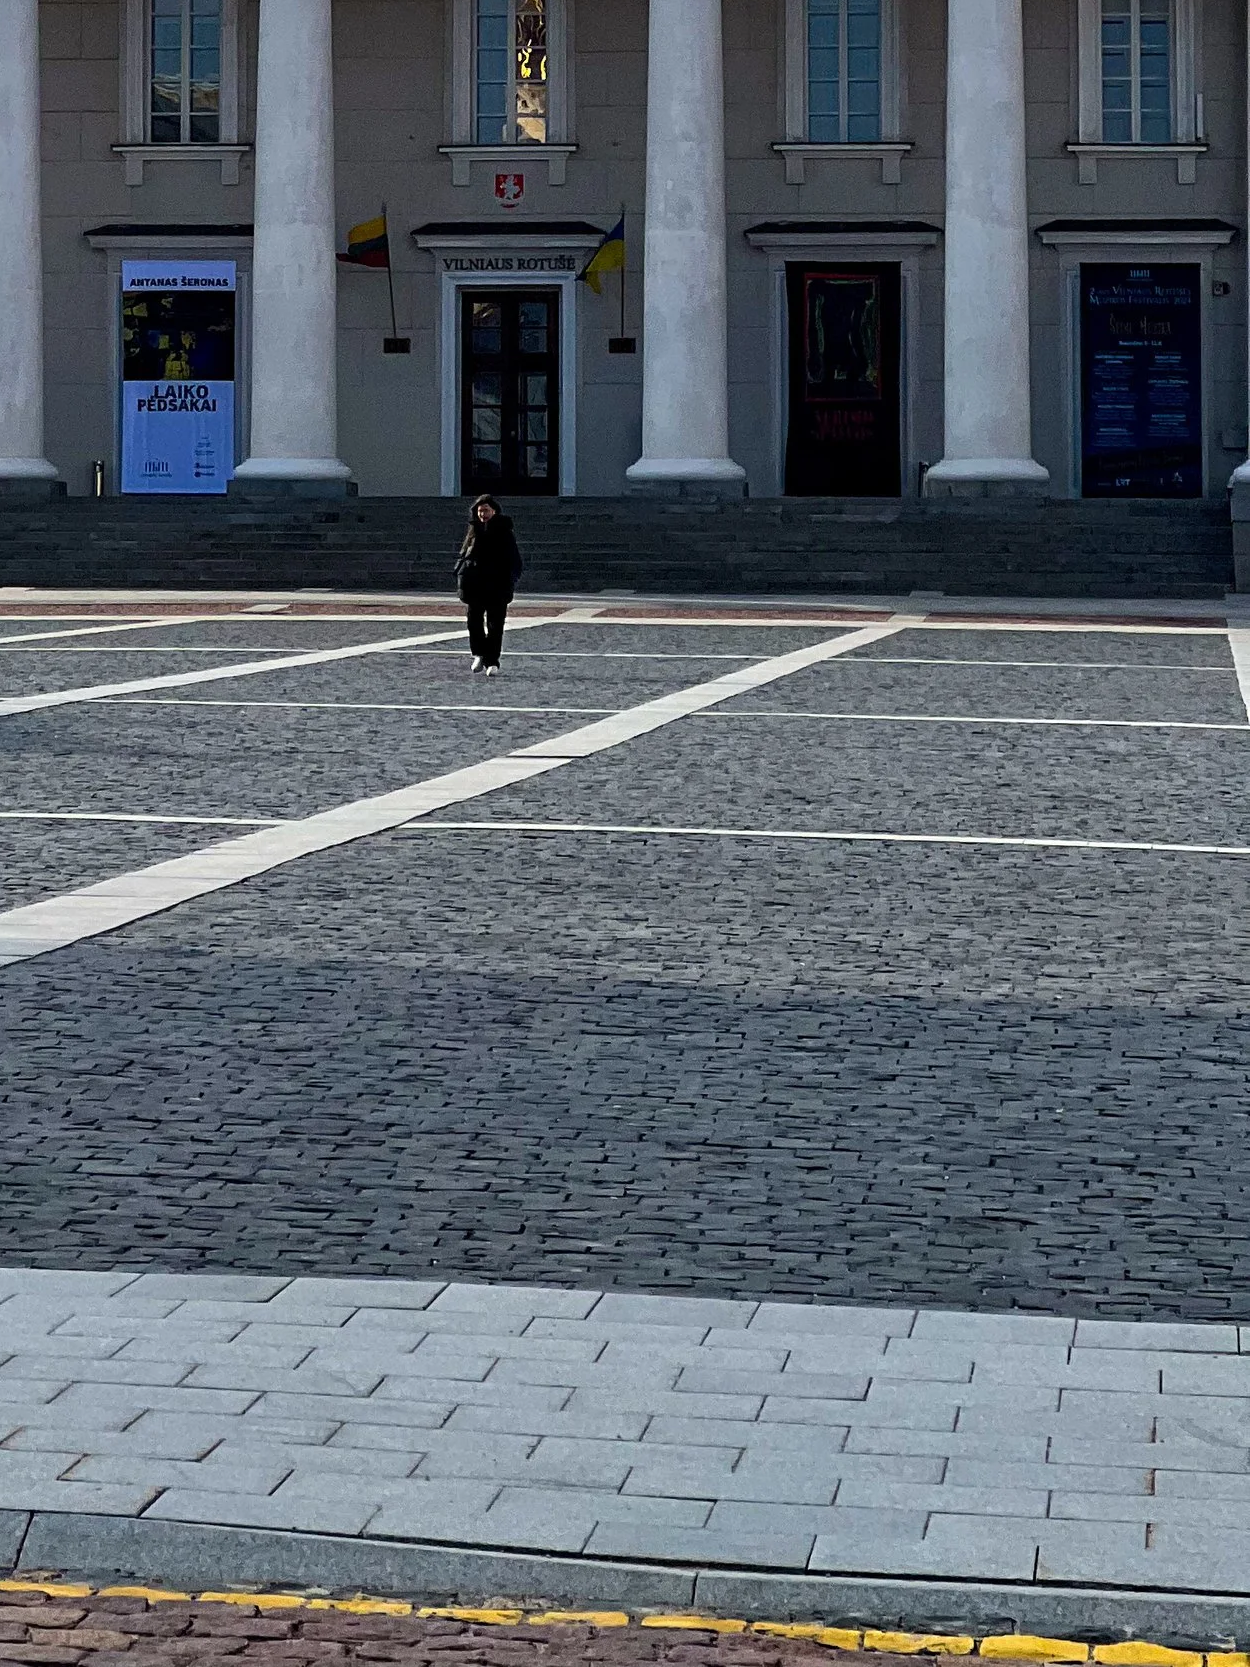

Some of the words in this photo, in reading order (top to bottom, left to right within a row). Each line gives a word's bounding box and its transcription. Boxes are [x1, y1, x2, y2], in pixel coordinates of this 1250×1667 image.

[442, 257, 513, 271] VILNIAUS
[516, 254, 576, 270] ROTUŠĖ
[130, 277, 178, 287] ANTANAS
[181, 275, 228, 287] ŠERONAS
[154, 384, 209, 399] LAIKO
[137, 396, 217, 412] PĖDSAKAI
